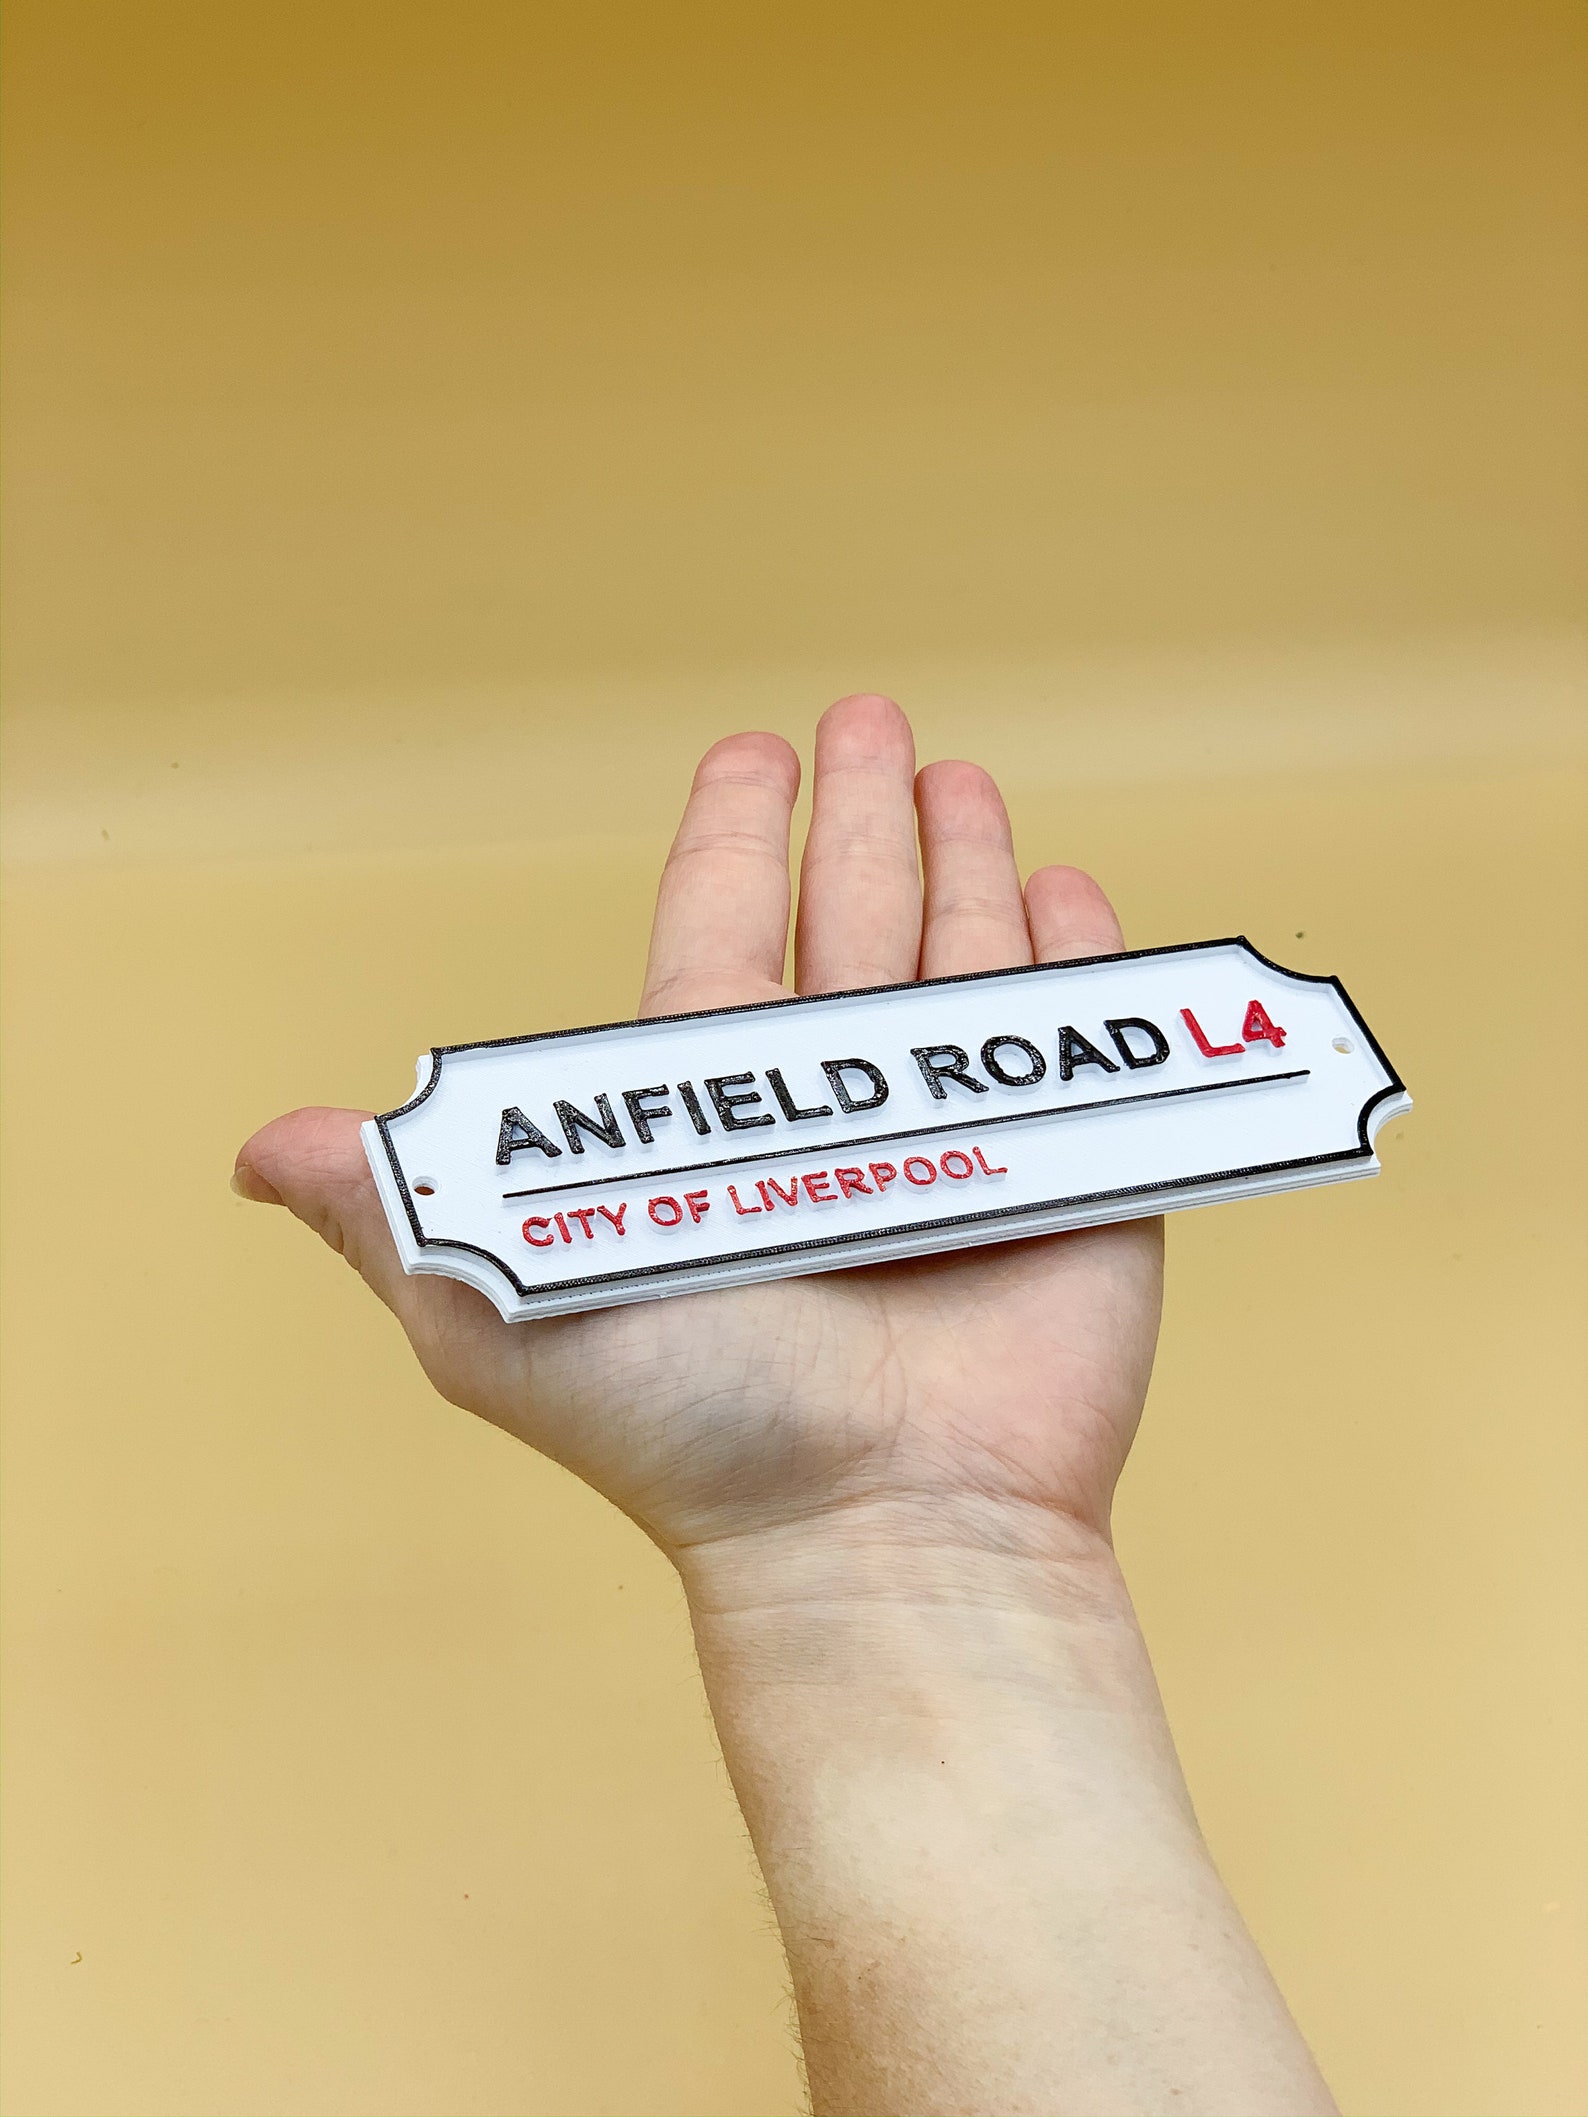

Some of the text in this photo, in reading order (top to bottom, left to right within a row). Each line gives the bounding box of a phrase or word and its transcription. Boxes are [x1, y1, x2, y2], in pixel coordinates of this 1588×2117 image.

[495, 999, 1287, 1166] ANFIELD ROAD L4
[522, 1146, 1008, 1248] CITY OF LIVERPOOL
